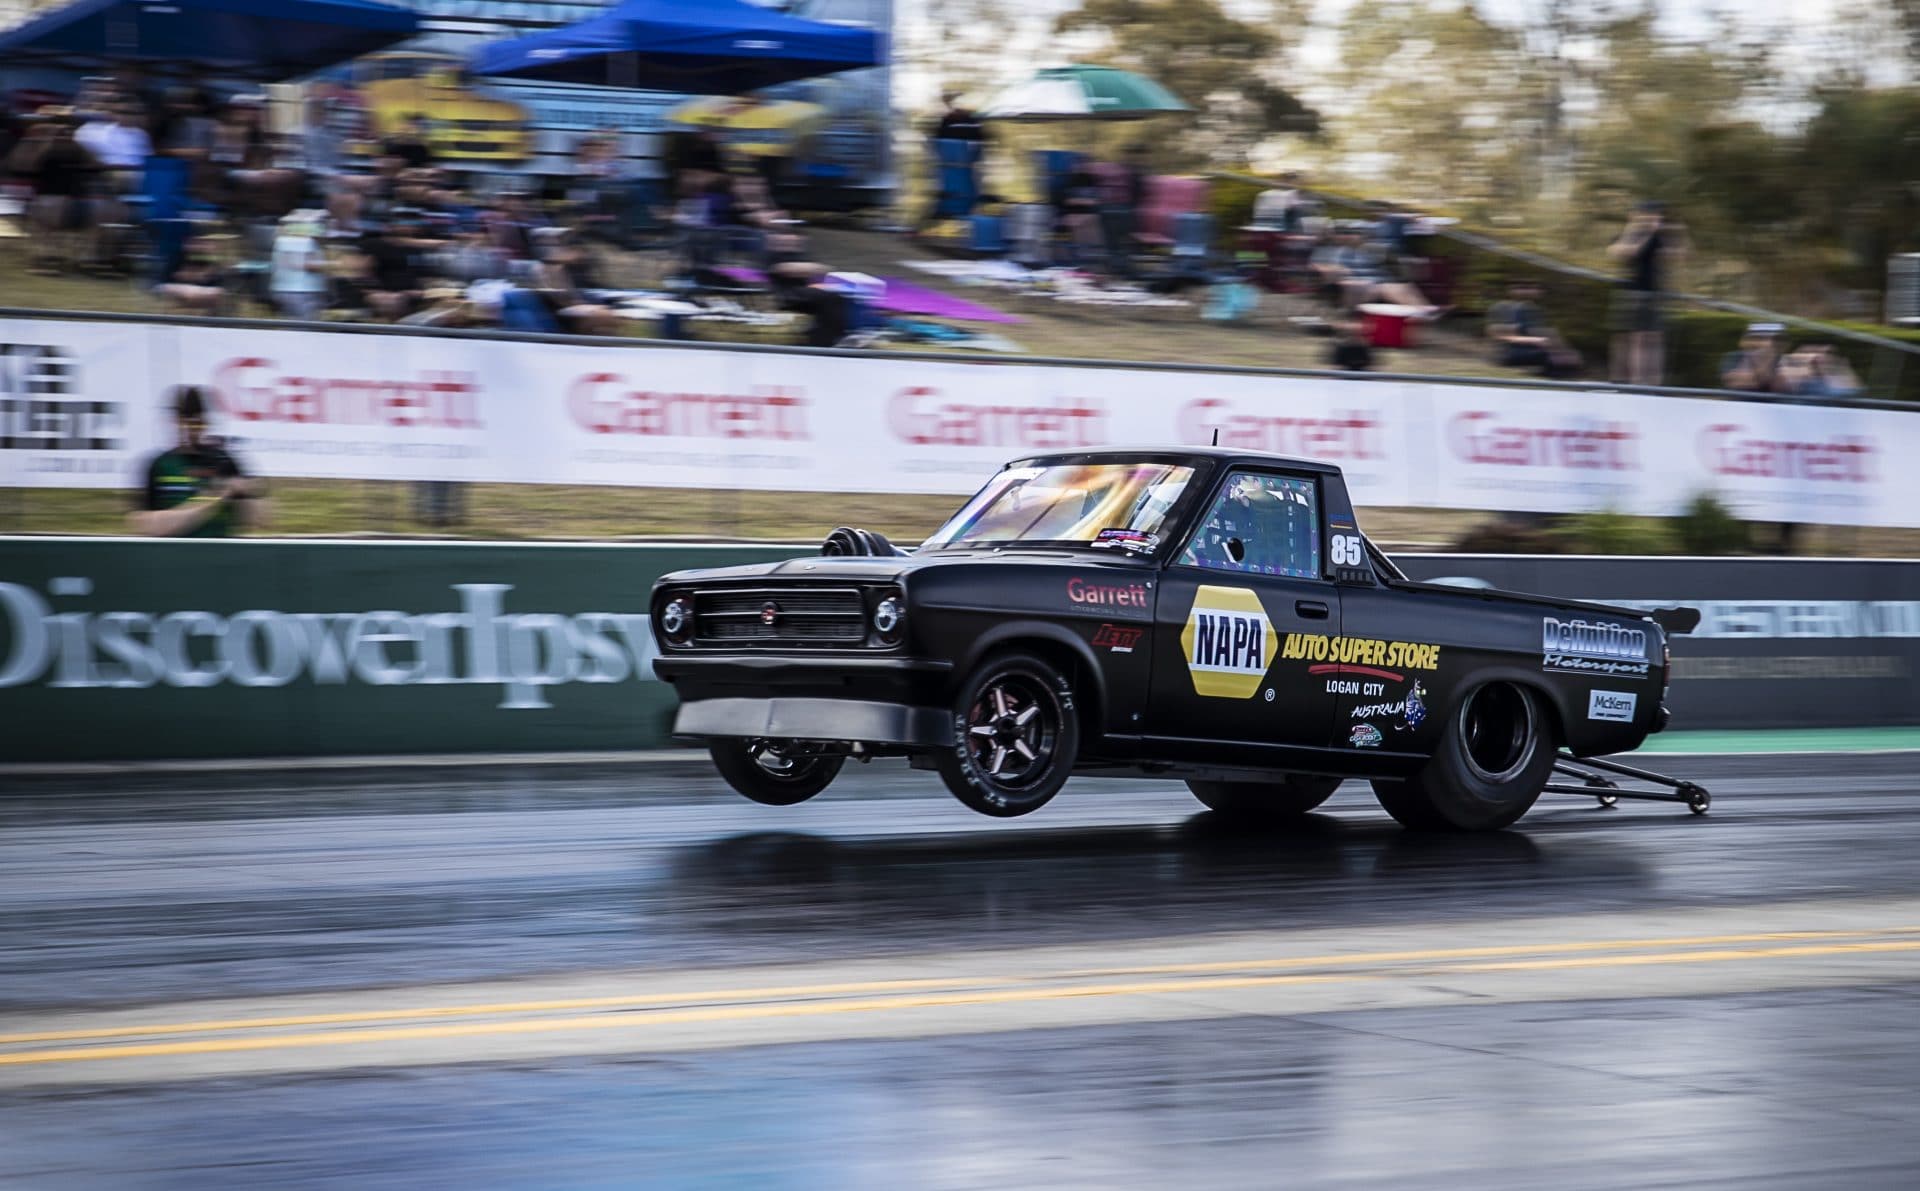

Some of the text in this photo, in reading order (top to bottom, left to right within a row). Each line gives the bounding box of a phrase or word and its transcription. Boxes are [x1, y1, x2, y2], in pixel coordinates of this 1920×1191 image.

[210, 357, 485, 428] Garrett
[567, 373, 813, 441] Garrett
[887, 387, 1111, 448] Garrett
[1446, 411, 1643, 470] Garrett
[1697, 424, 1886, 483] Garrett
[1331, 534, 1361, 566] 85
[1067, 577, 1147, 607] Garrett
[1196, 614, 1262, 669] NAPA
[1282, 633, 1441, 670] AUTO SUPER STORE
[1543, 617, 1646, 658] Definition
[1543, 654, 1649, 674] Motorsport
[1326, 680, 1385, 697] LOGAN CITY
[1351, 701, 1405, 718] AUSTRALIA
